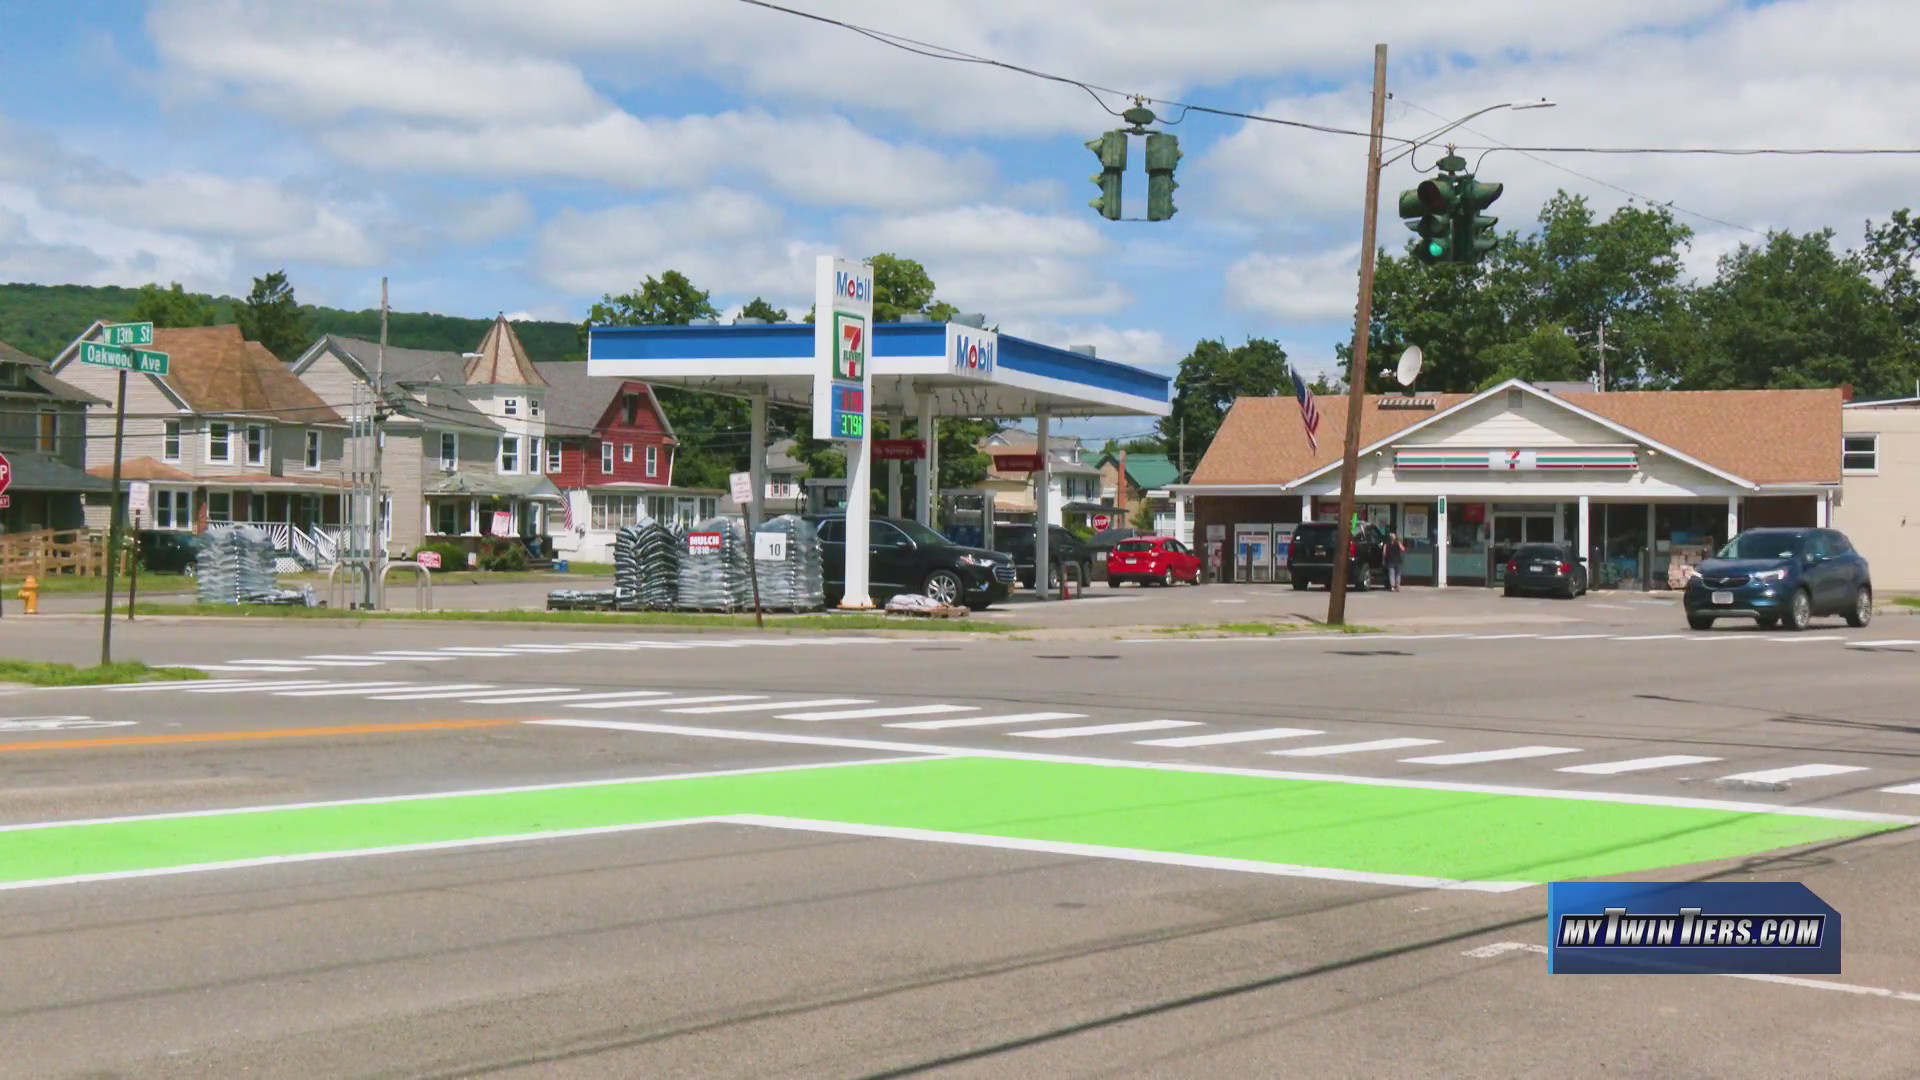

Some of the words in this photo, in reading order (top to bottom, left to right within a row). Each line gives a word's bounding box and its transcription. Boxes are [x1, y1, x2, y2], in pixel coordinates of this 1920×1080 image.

[836, 271, 870, 302] Mobil
[117, 327, 133, 344] 13th
[141, 325, 151, 342] St
[87, 345, 133, 368] Oakwood
[141, 353, 161, 371] Ave
[844, 324, 862, 377] 7
[956, 334, 993, 373] Mobil
[689, 535, 720, 546] MULCH
[769, 543, 781, 556] 10
